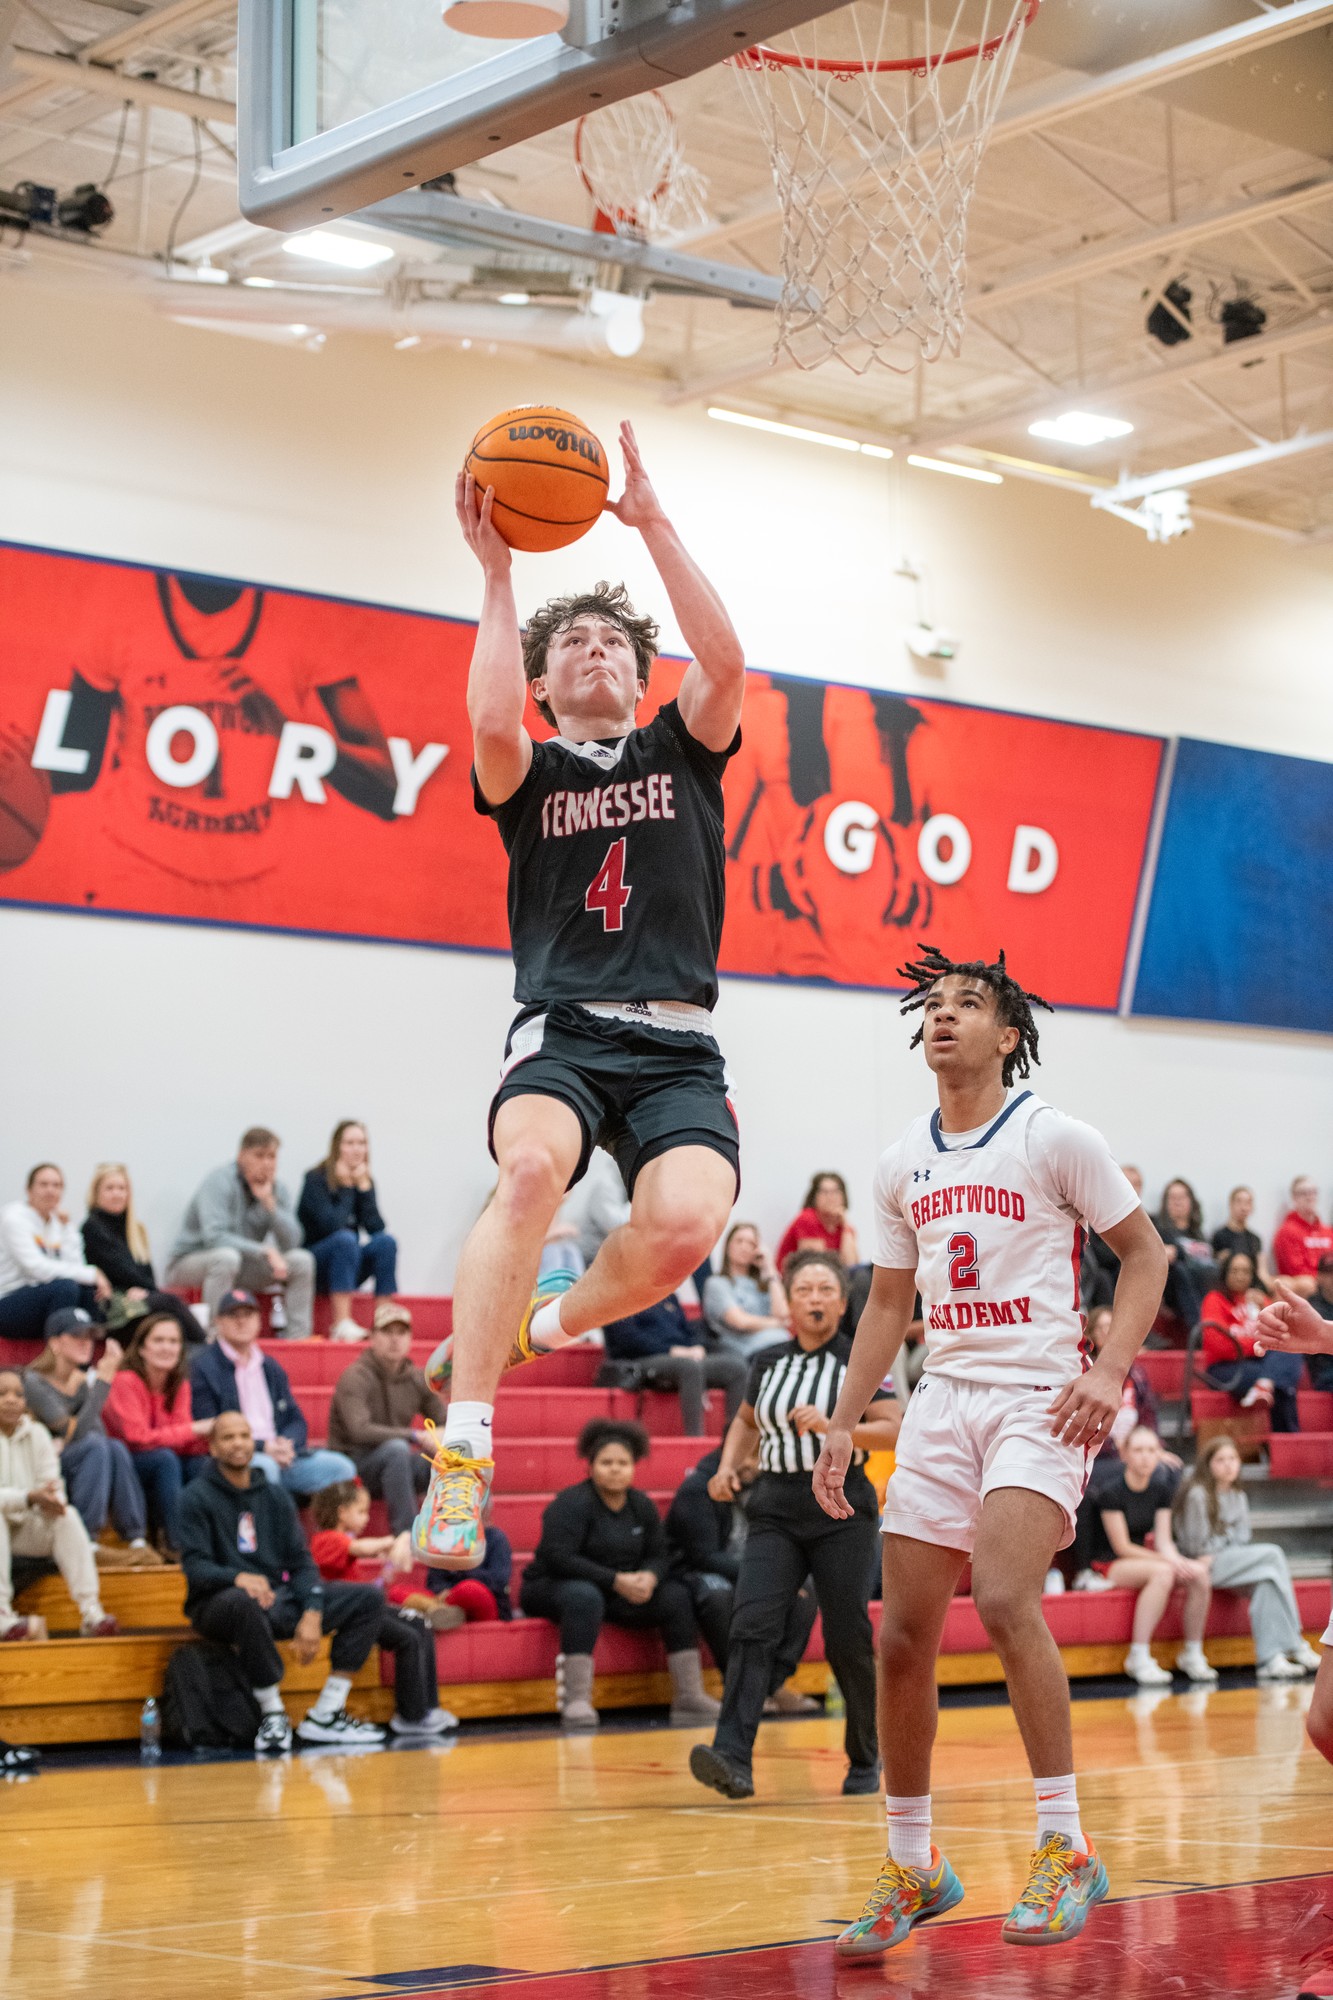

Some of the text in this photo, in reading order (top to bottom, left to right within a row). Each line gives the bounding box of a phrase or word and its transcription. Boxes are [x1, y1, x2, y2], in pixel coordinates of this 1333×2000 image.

[507, 425, 600, 467] Wilson
[542, 774, 676, 839] TENNESSEE
[824, 800, 1059, 894] GOD
[585, 836, 632, 932] 4
[626, 1004, 652, 1017] adidas
[911, 1184, 1026, 1229] BRENTWOOD
[947, 1231, 981, 1292] 2
[928, 1296, 1032, 1331] ACADEMY
